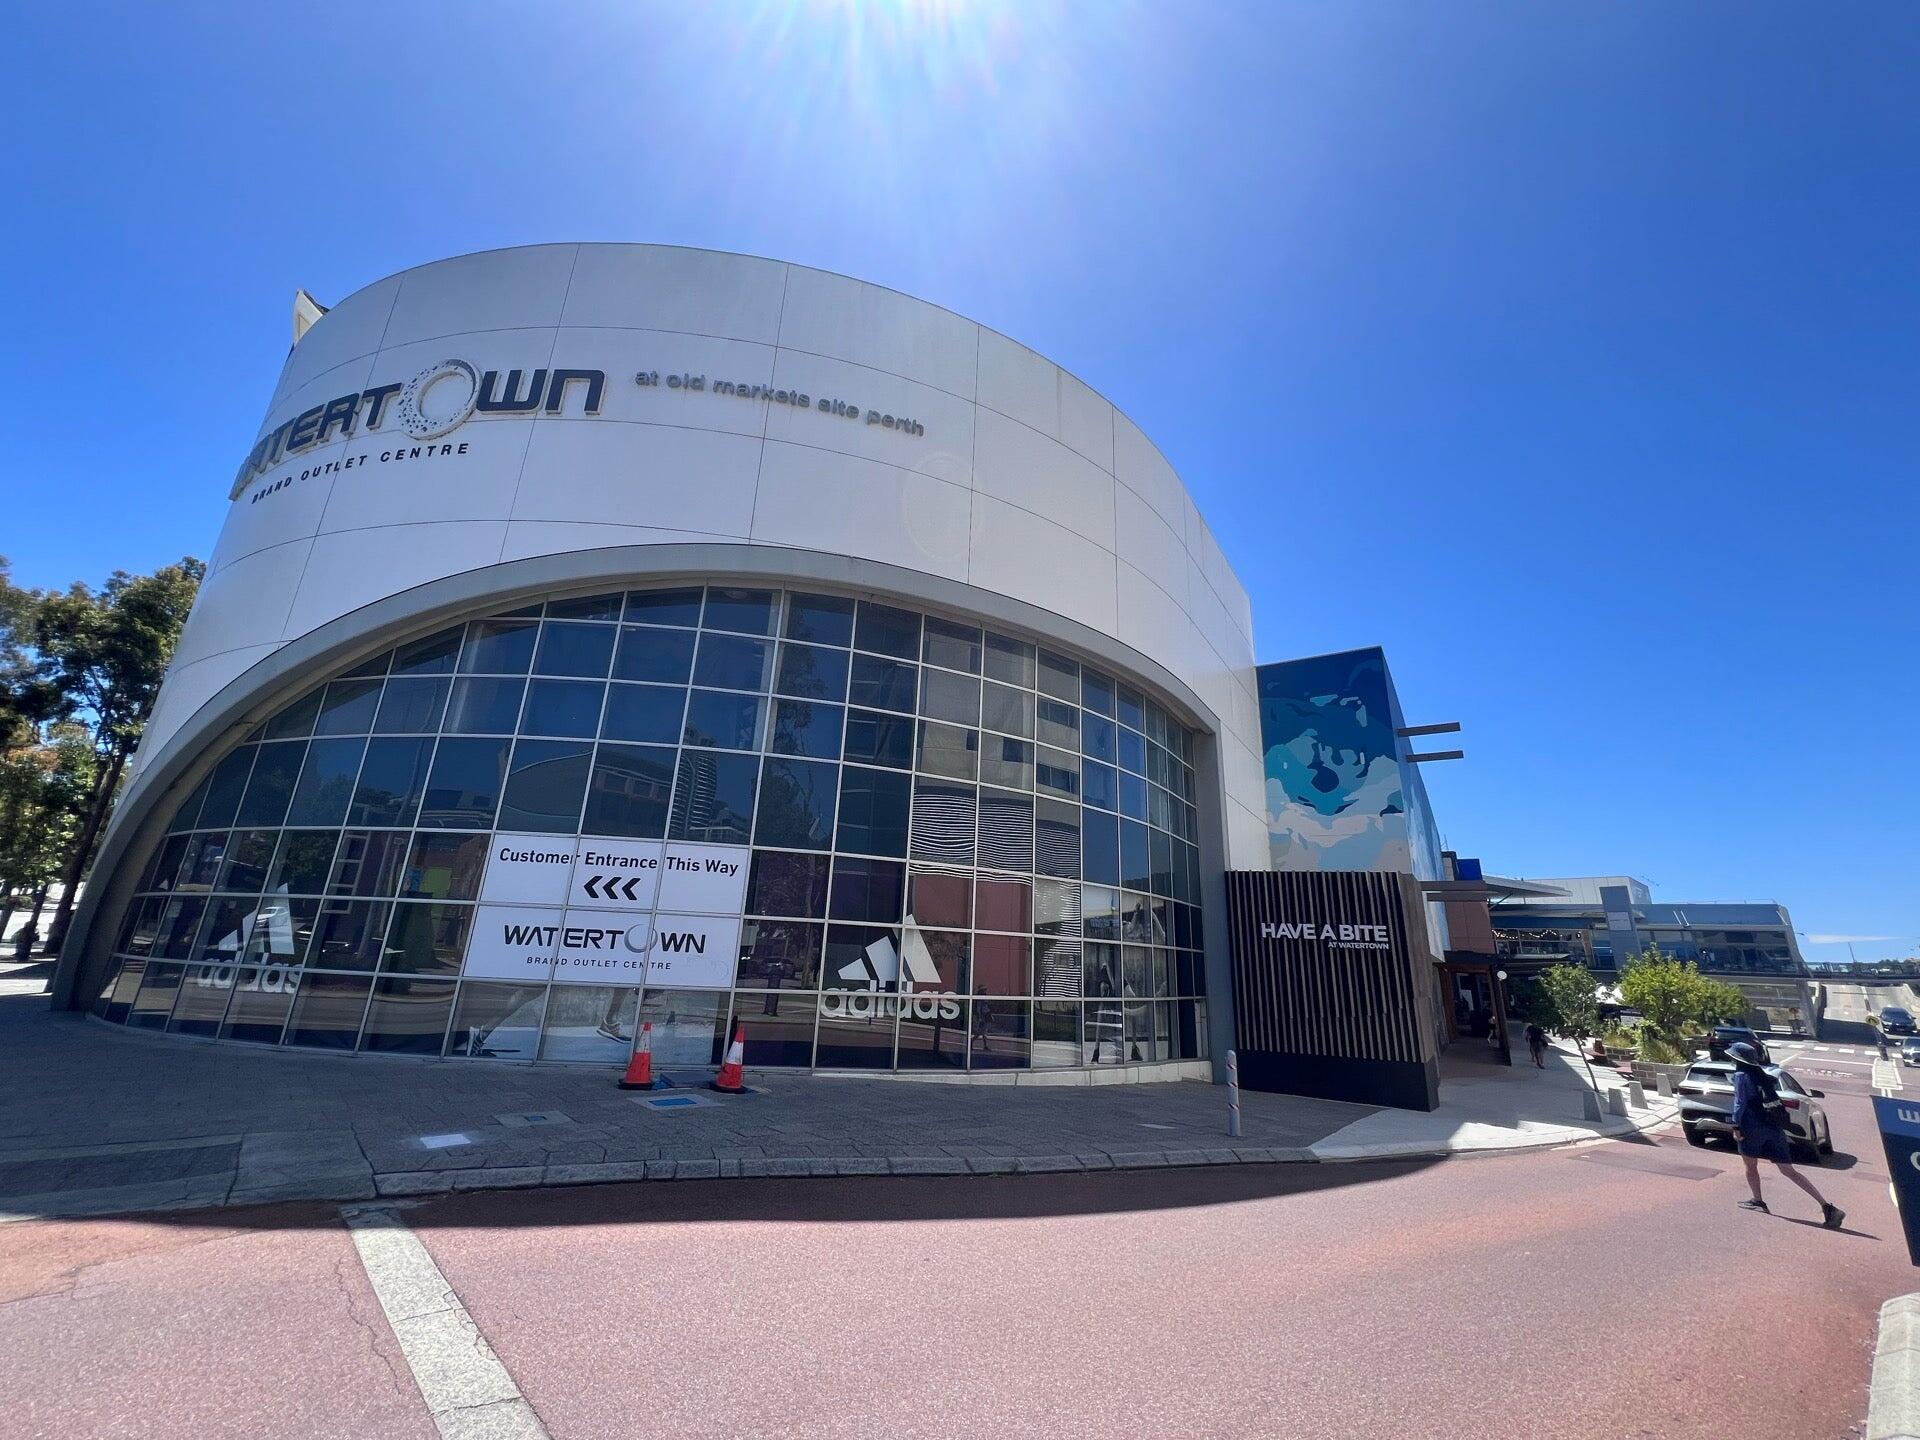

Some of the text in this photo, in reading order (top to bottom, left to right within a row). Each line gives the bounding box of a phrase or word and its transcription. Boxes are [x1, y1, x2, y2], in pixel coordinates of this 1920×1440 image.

[635, 371, 924, 437] at old markets site perth
[251, 443, 469, 504] BRAND OUTLET CENTRE
[500, 848, 739, 877] Customer Entrance This Way
[504, 924, 706, 954] WATERTOWN
[1261, 922, 1389, 942] HAVE A BITE
[198, 951, 302, 993] addas
[573, 959, 618, 969] OUTLET
[820, 980, 960, 1020] adidas
